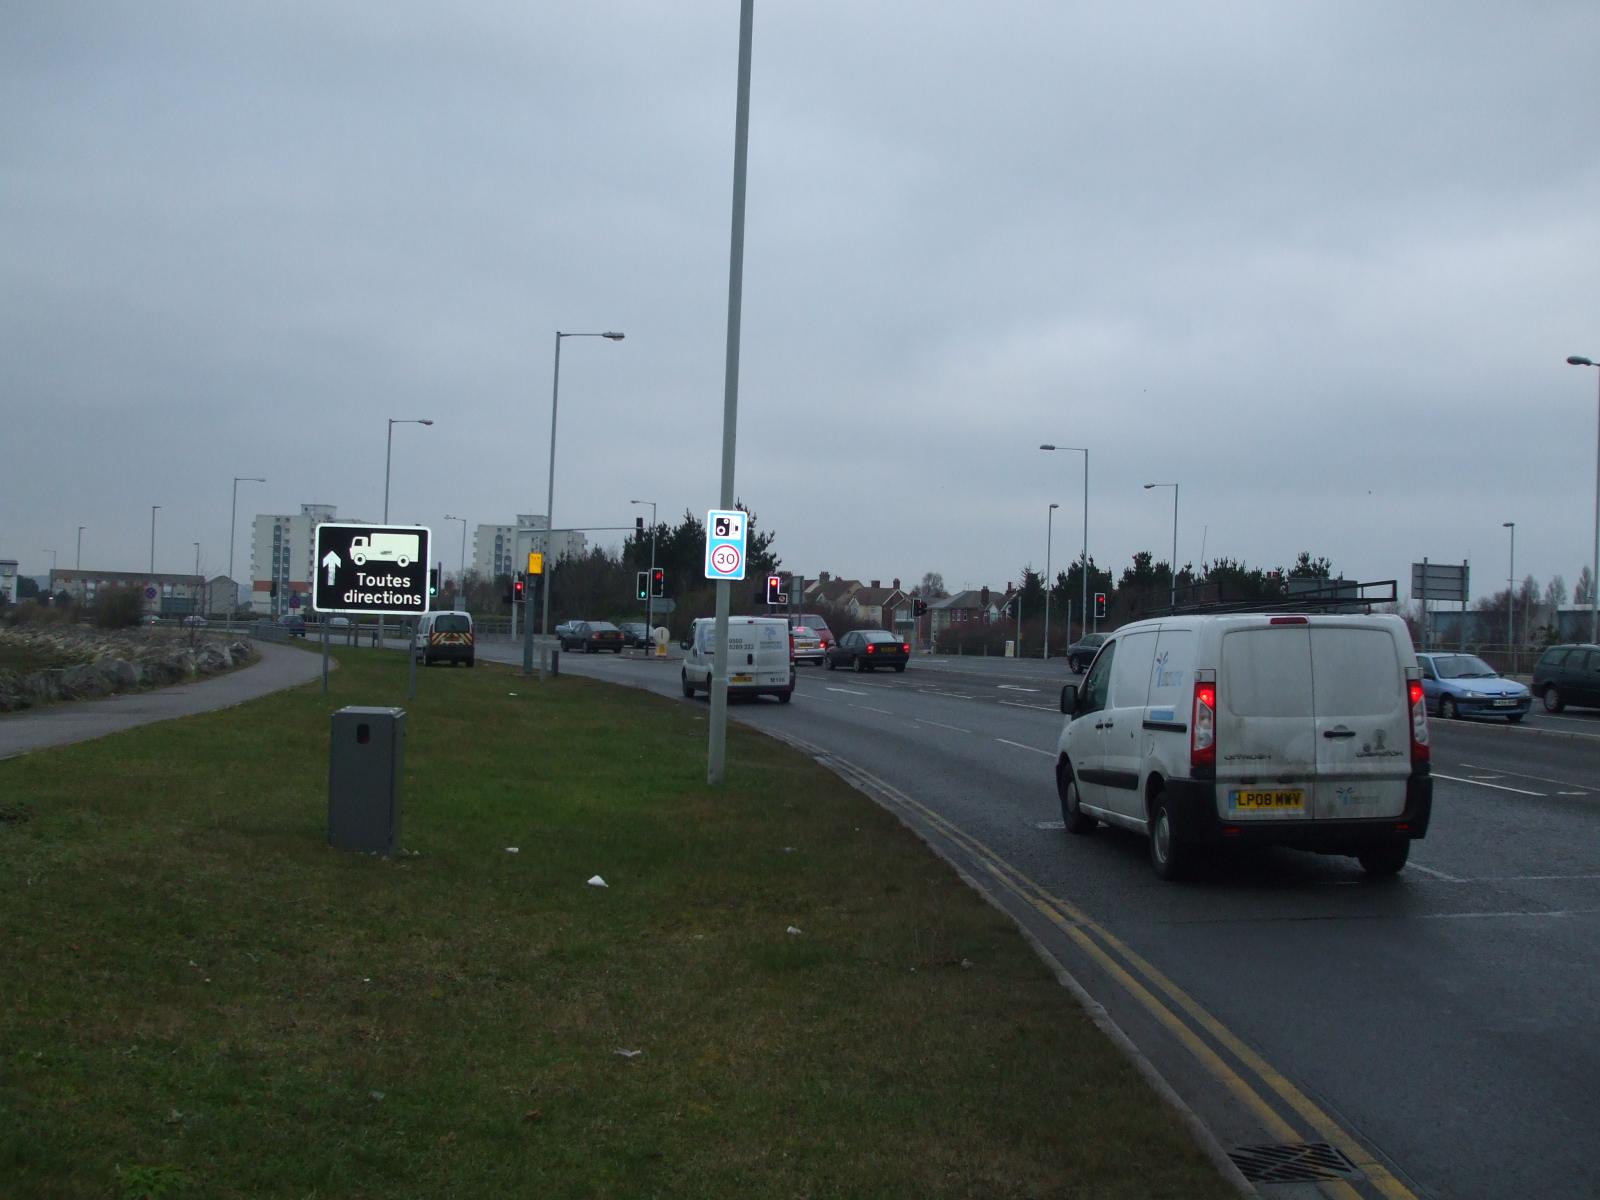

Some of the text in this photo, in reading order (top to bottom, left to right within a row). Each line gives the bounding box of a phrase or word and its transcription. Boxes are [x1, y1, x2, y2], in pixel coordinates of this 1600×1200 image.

[717, 553, 735, 565] 30
[356, 572, 411, 588] Toutes
[343, 589, 422, 605] directions
[1237, 791, 1302, 807] LP08 MWV
